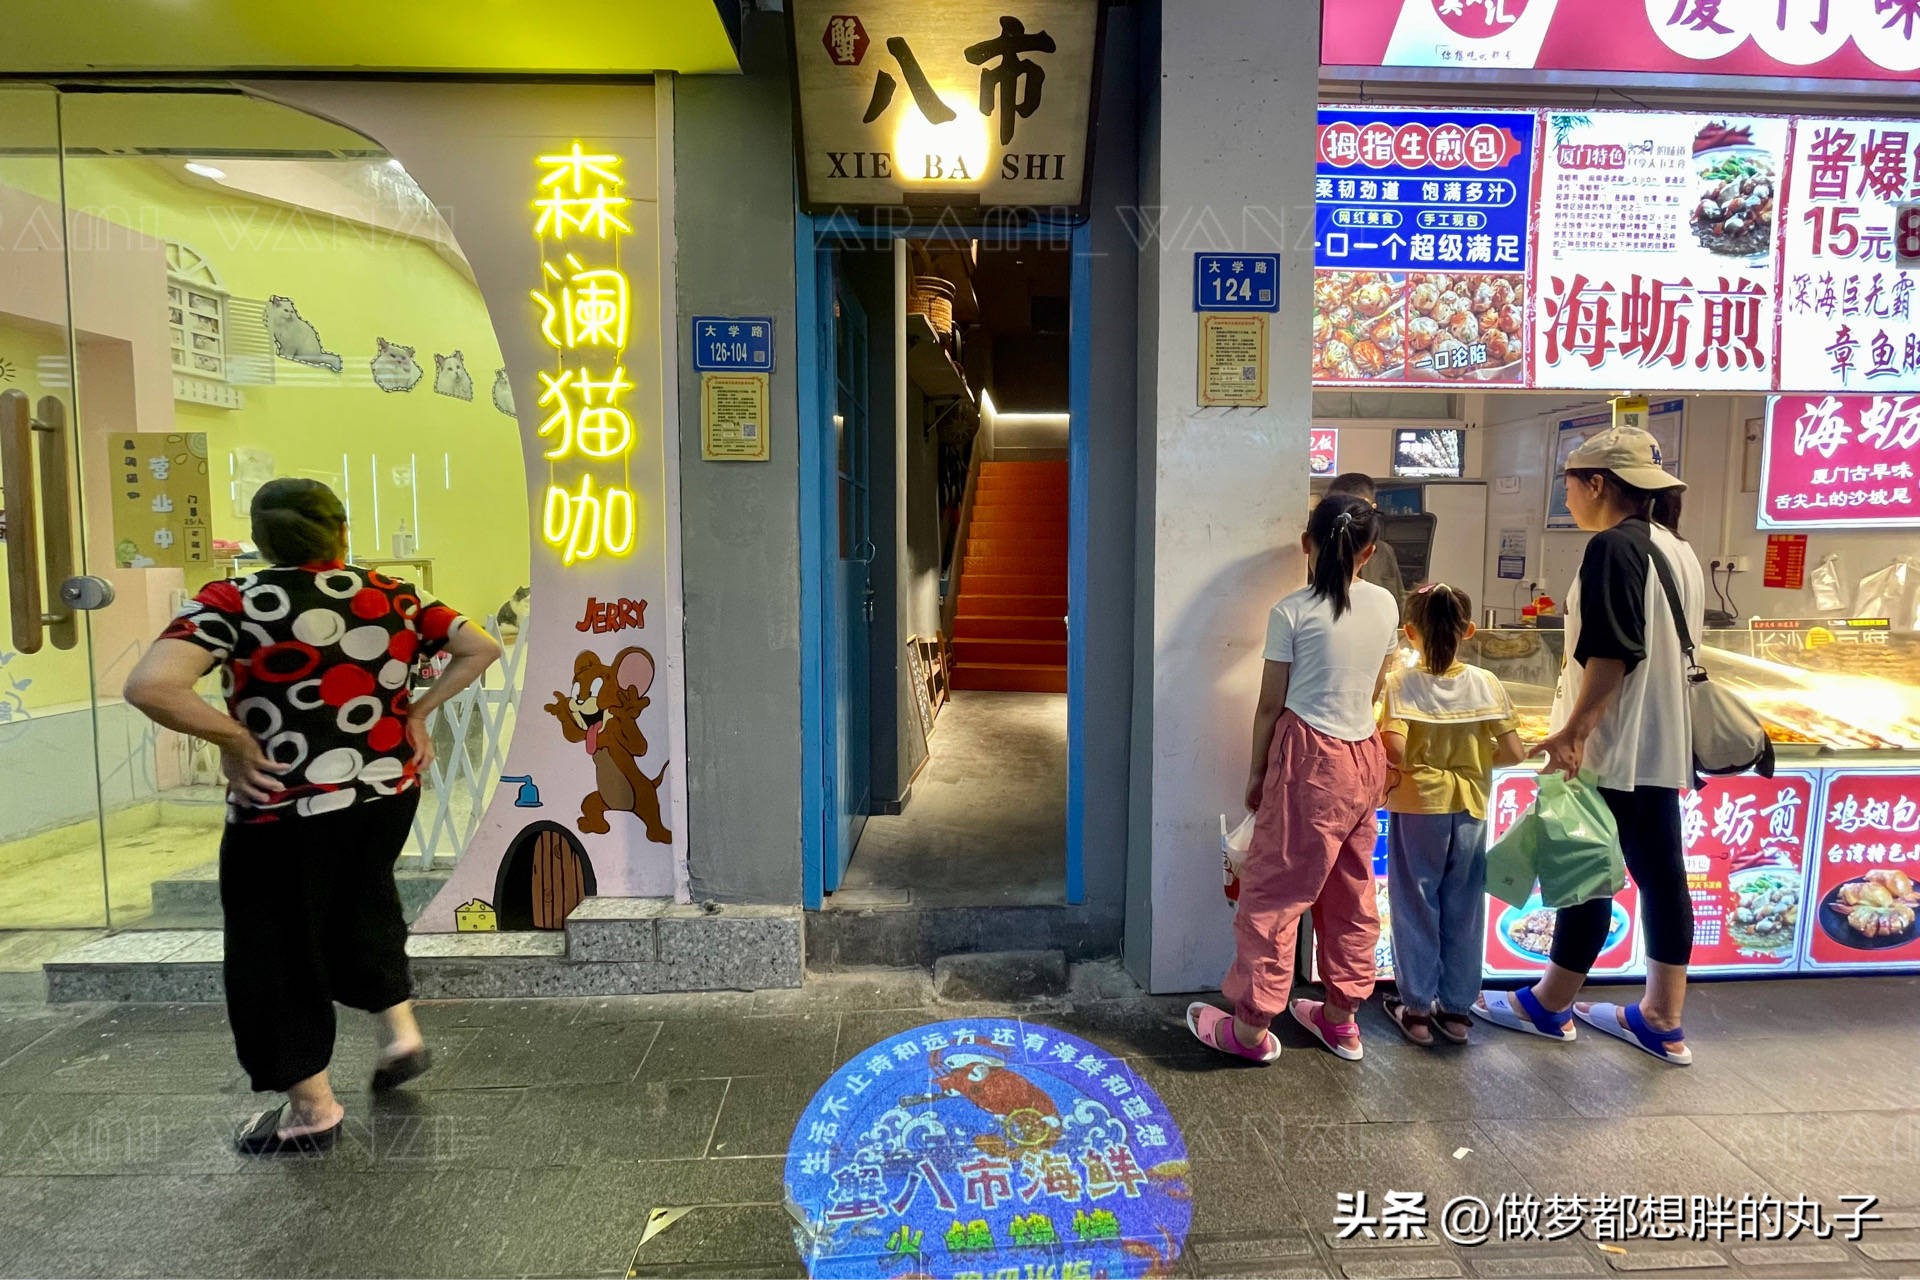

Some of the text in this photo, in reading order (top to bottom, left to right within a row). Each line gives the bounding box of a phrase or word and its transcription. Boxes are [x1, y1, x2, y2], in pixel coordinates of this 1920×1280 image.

[827, 18, 860, 63] 蟹
[863, 16, 1056, 145] 八市
[1326, 130, 1498, 163] 拇指生煎包
[1560, 147, 1623, 166] 厦门特色
[827, 152, 1066, 181] XIE BA SHI
[1808, 127, 1920, 200] 酱爆
[1316, 179, 1506, 202] 柔韧劲道 饱满多汁
[1338, 211, 1479, 227] 网红美食 手工现包
[1315, 233, 1520, 262] 口一个超级满足
[1208, 261, 1267, 274] 大学路
[1212, 277, 1251, 301] 124
[1789, 270, 1914, 321] 深海巨无霸
[705, 325, 763, 337] 大学路
[1542, 274, 1768, 369] 海蛎煎
[533, 144, 636, 564] 森澜猫咖
[710, 342, 748, 362] 126-104
[1415, 344, 1487, 370] 一口沦陷
[1794, 395, 1920, 458] 海蛎
[1811, 462, 1914, 485] 厦门古早味
[1774, 487, 1912, 510] 舌尖上的沙坡尾
[575, 596, 648, 635] JERRY
[1827, 793, 1920, 833] 鸡翅包
[824, 1143, 1149, 1225] 蟹八市海鲜
